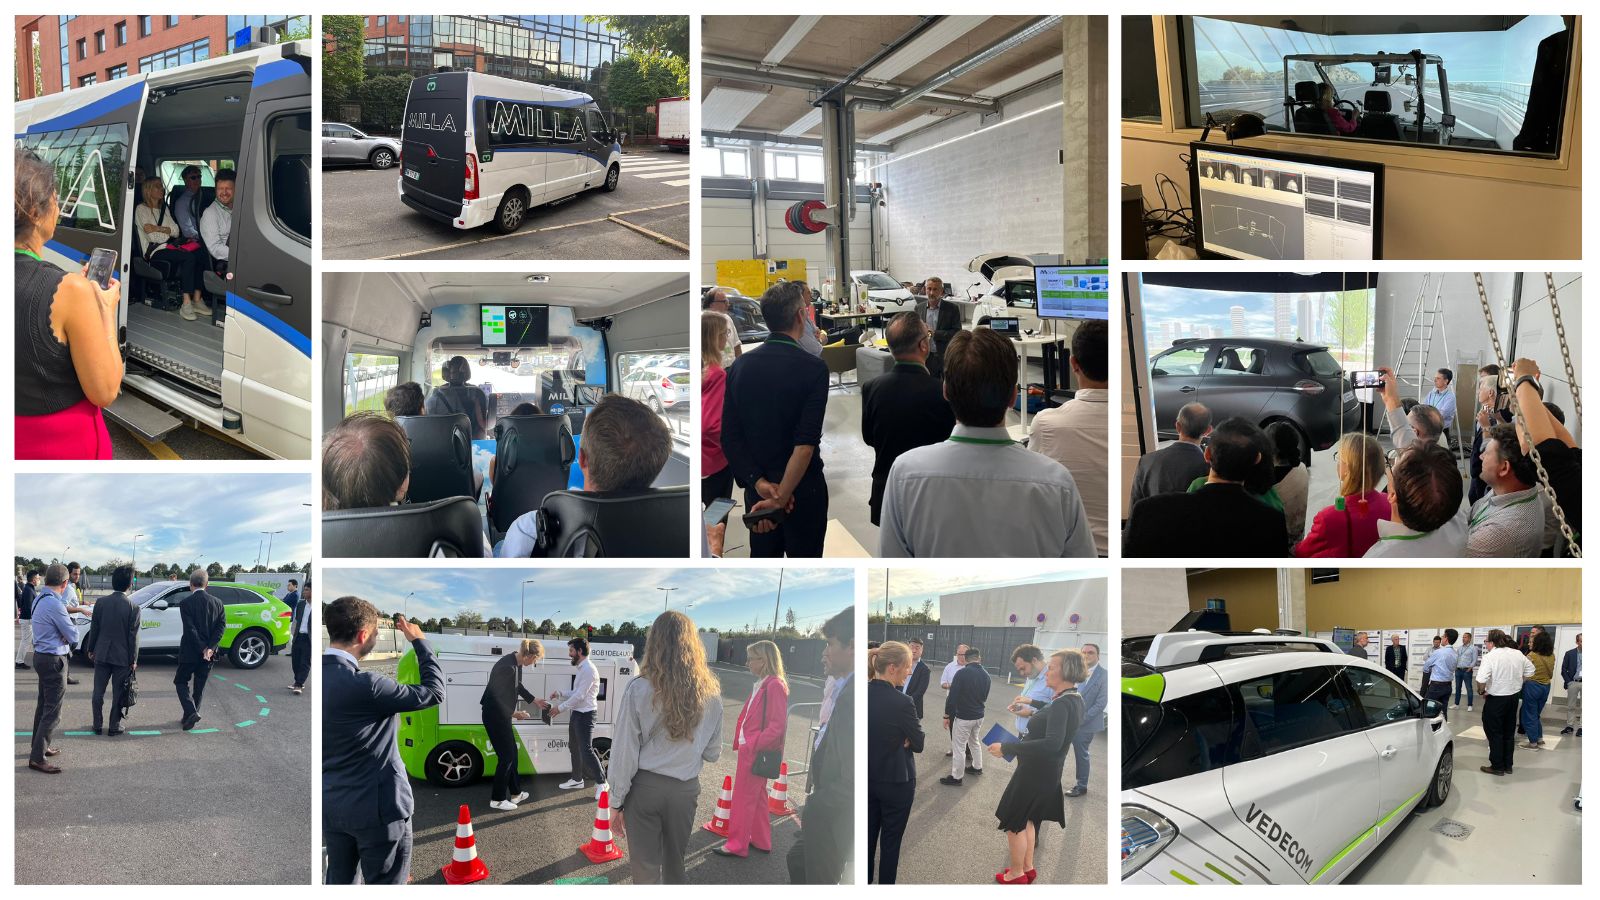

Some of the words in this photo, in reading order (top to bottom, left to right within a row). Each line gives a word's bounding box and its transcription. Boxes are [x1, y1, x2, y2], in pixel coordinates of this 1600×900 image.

[408, 113, 456, 132] MILLA
[491, 101, 586, 141] MILLA
[548, 392, 569, 401] MIL
[547, 739, 570, 748] eDeliv
[1245, 802, 1314, 874] VEDECOM
